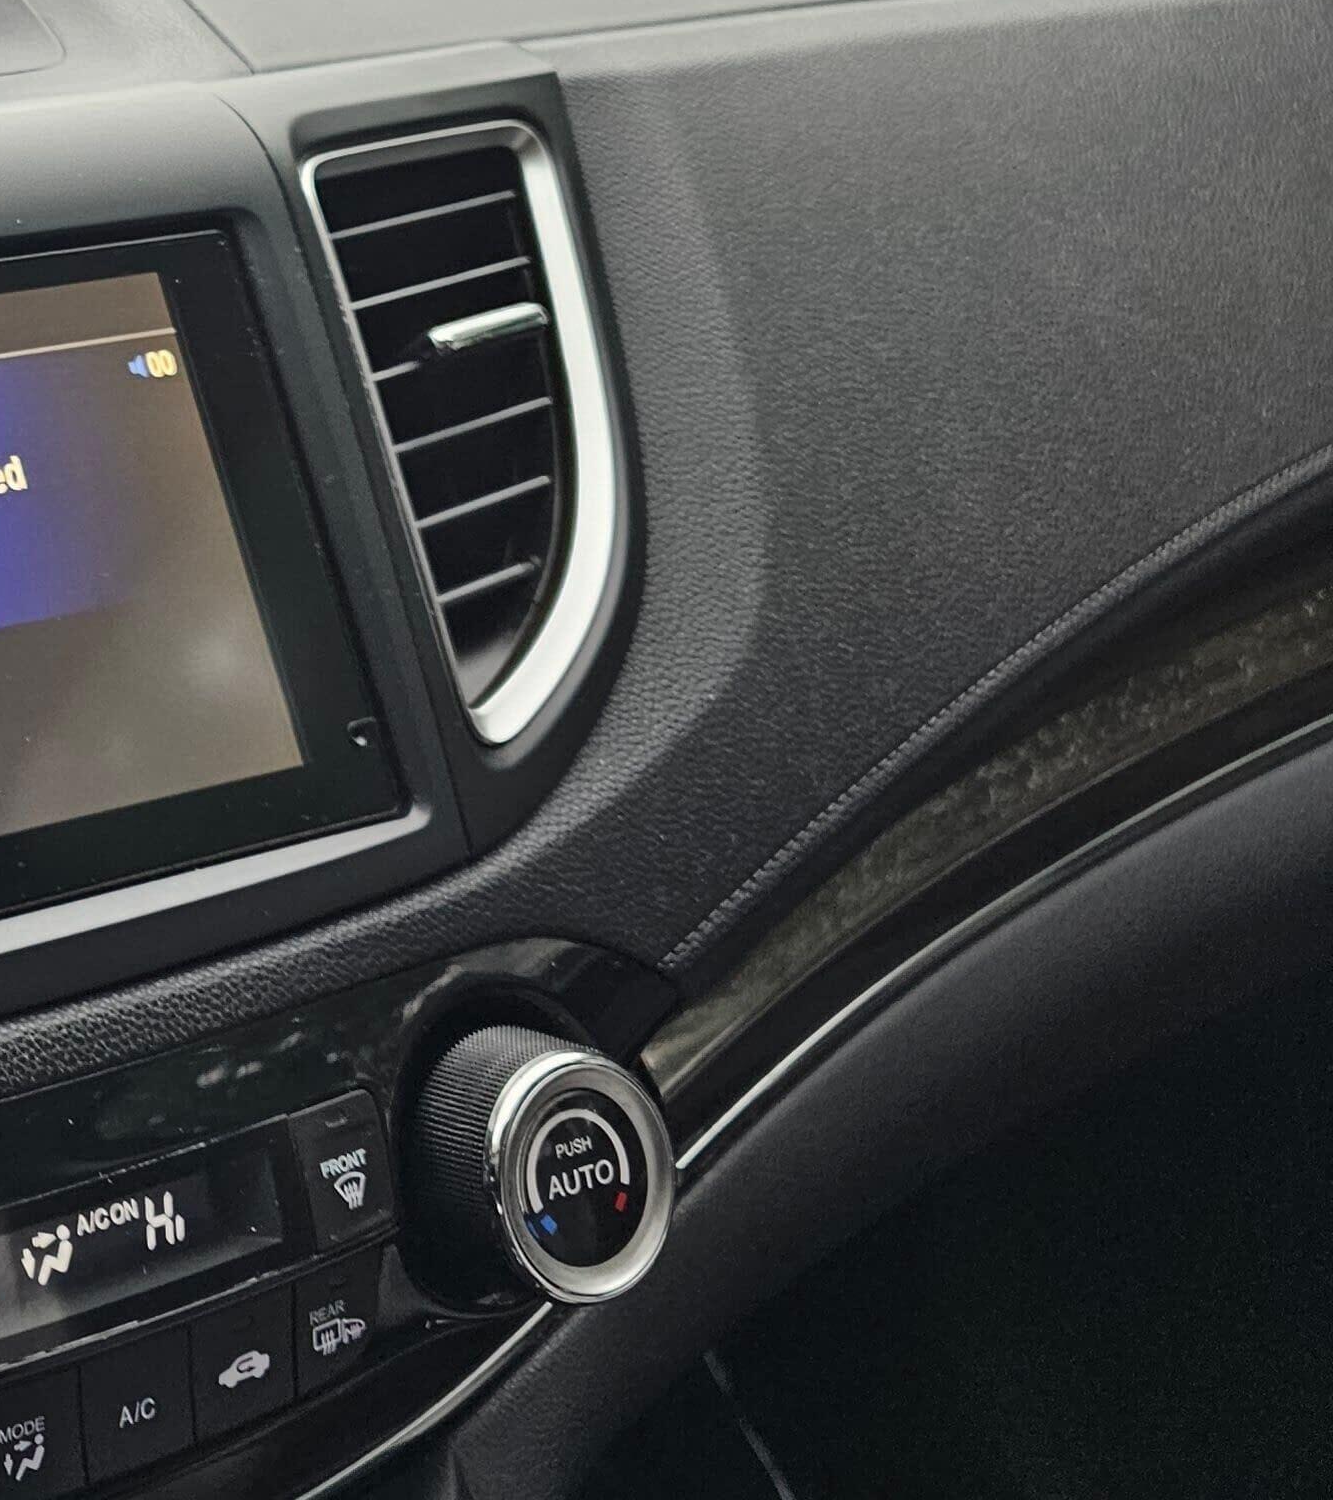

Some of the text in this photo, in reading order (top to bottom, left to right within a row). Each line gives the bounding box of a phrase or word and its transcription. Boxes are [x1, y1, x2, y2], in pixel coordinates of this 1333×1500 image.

[555, 1135, 593, 1159] PUSH
[320, 1148, 367, 1180] FRONT
[548, 1159, 615, 1200] AUTO
[309, 1300, 346, 1326] REAR
[119, 1397, 157, 1428] A/C
